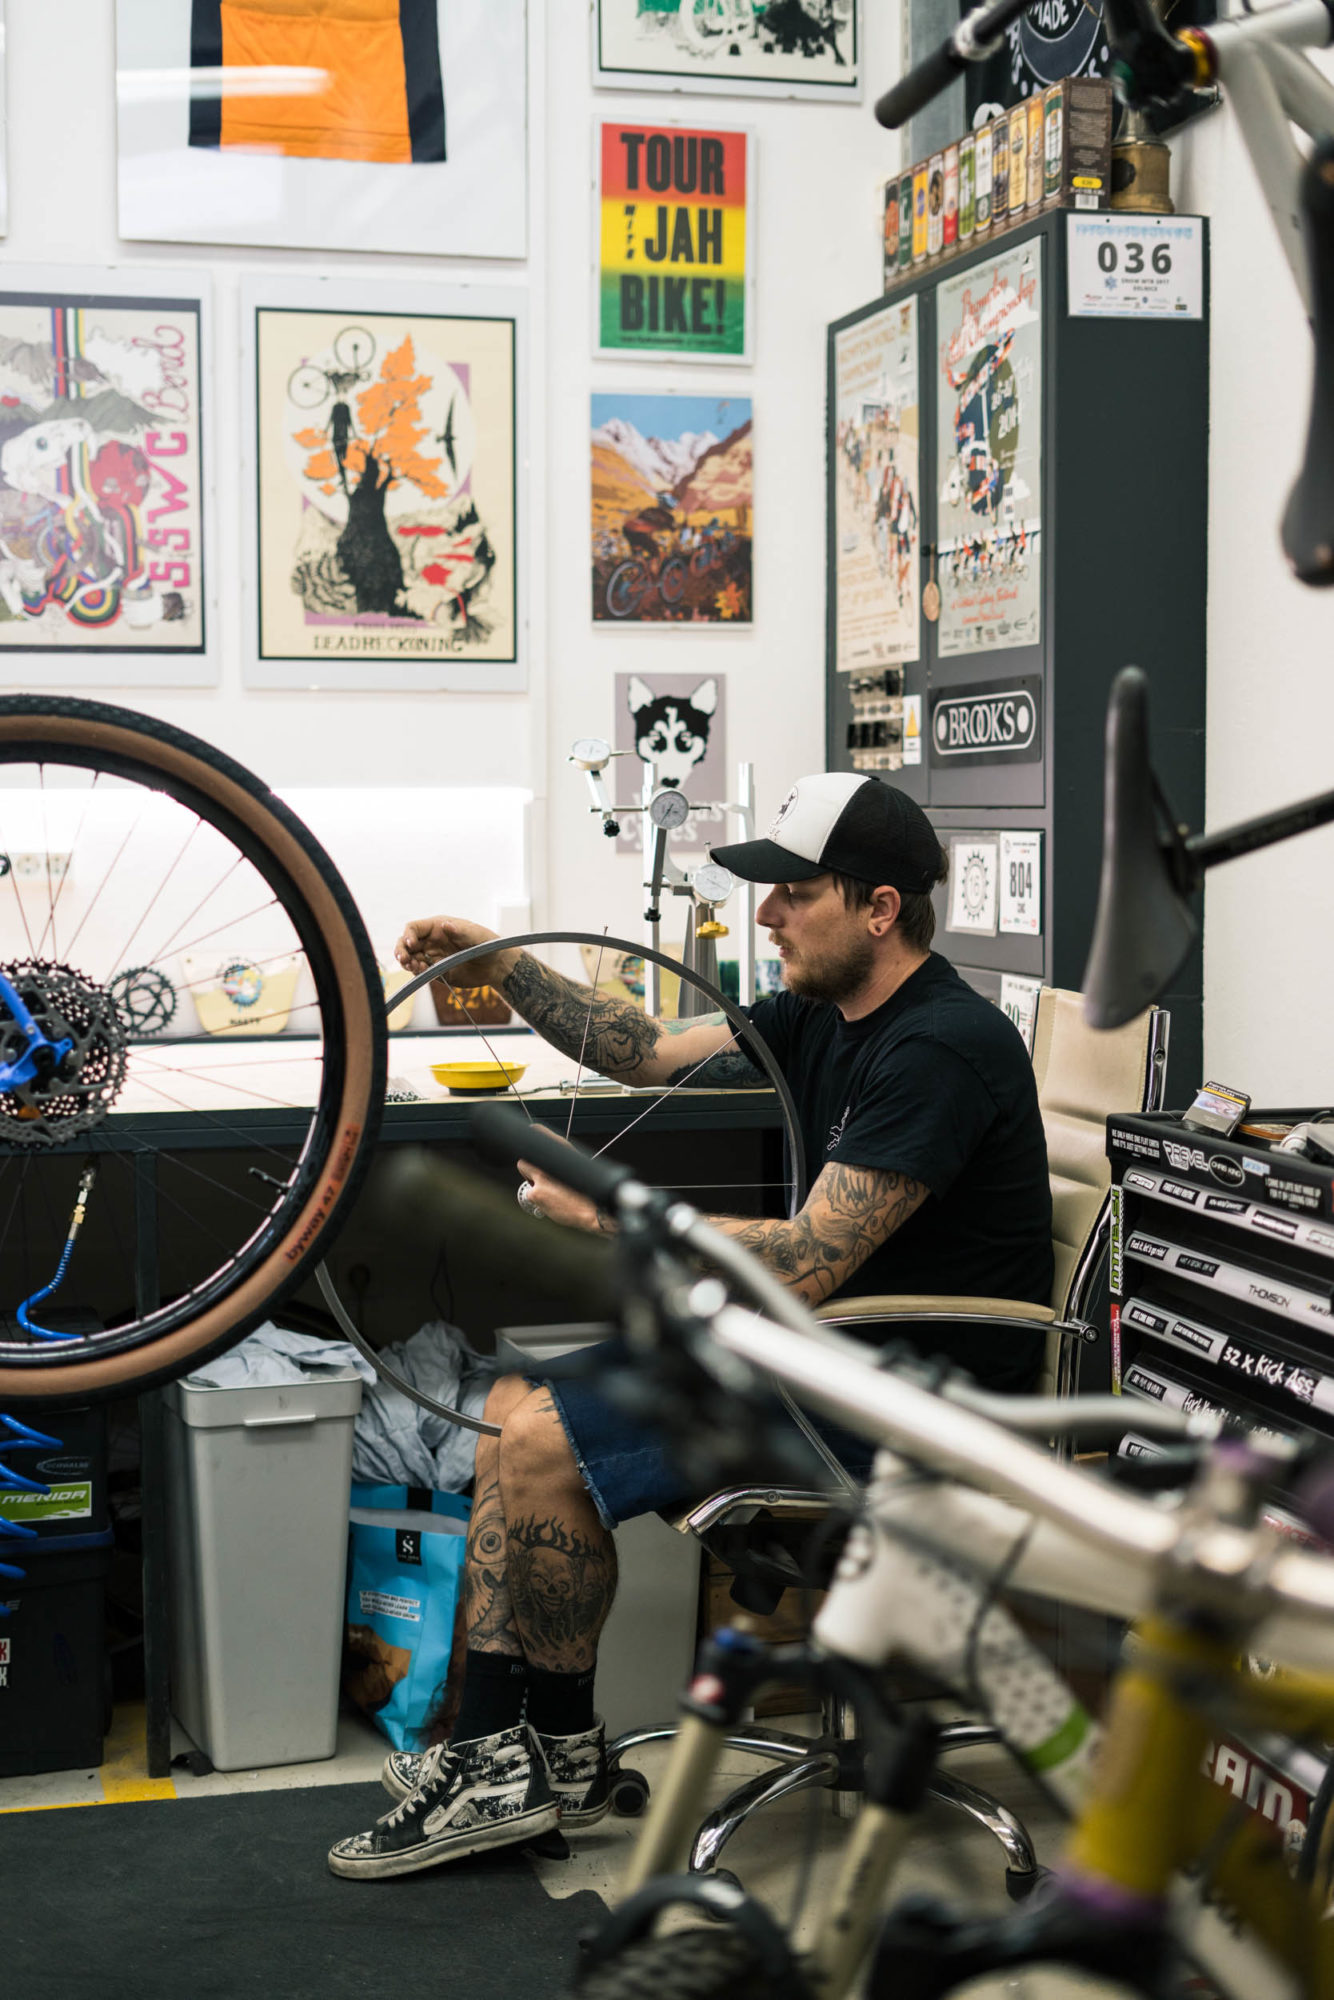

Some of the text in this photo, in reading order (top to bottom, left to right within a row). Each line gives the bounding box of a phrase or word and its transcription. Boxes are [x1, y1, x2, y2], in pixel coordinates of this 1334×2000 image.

[620, 132, 725, 196] TOUR
[644, 205, 723, 264] JAH
[1097, 241, 1172, 275] 036
[620, 274, 726, 335] BIKE!
[138, 432, 191, 588] SSWC
[948, 701, 1016, 746] BROOKS
[1010, 861, 1033, 899] 804
[1249, 1284, 1290, 1308] THOMSON
[1223, 1346, 1241, 1366] 32
